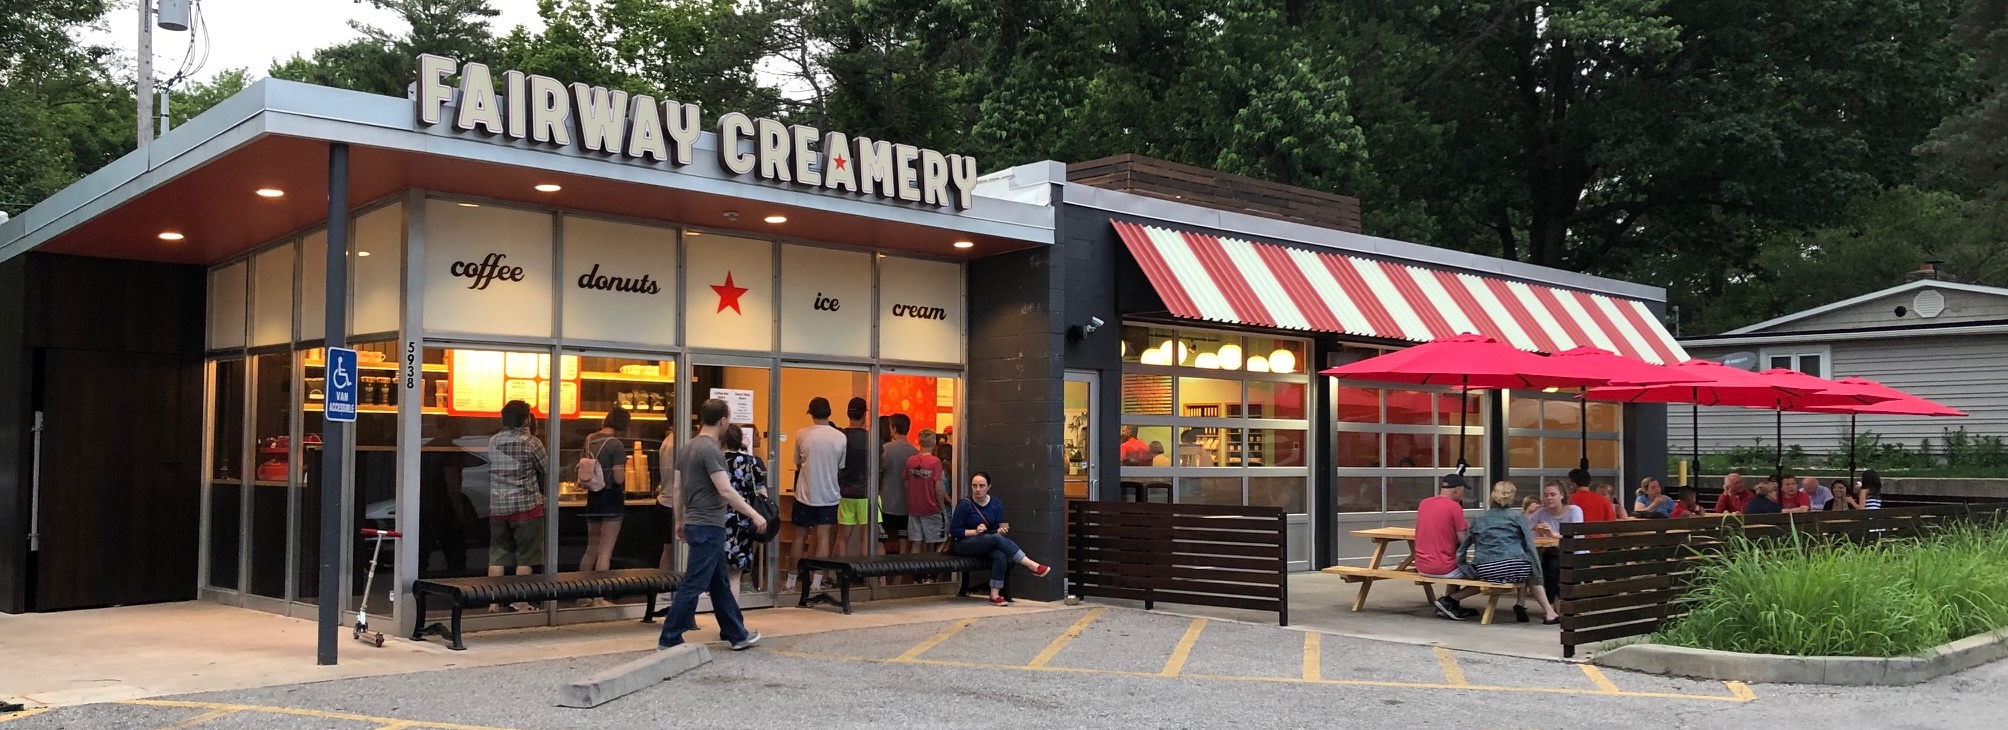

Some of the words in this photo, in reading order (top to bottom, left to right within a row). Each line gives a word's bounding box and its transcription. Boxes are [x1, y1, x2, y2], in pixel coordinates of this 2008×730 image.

[416, 53, 700, 165] FAIRWAY
[717, 111, 977, 210] CREAMERY
[450, 252, 525, 290] coffee
[577, 263, 661, 295] donuts
[813, 292, 840, 312] ice
[892, 303, 947, 321] cream
[406, 341, 415, 389] 5938
[336, 391, 349, 401] VAN
